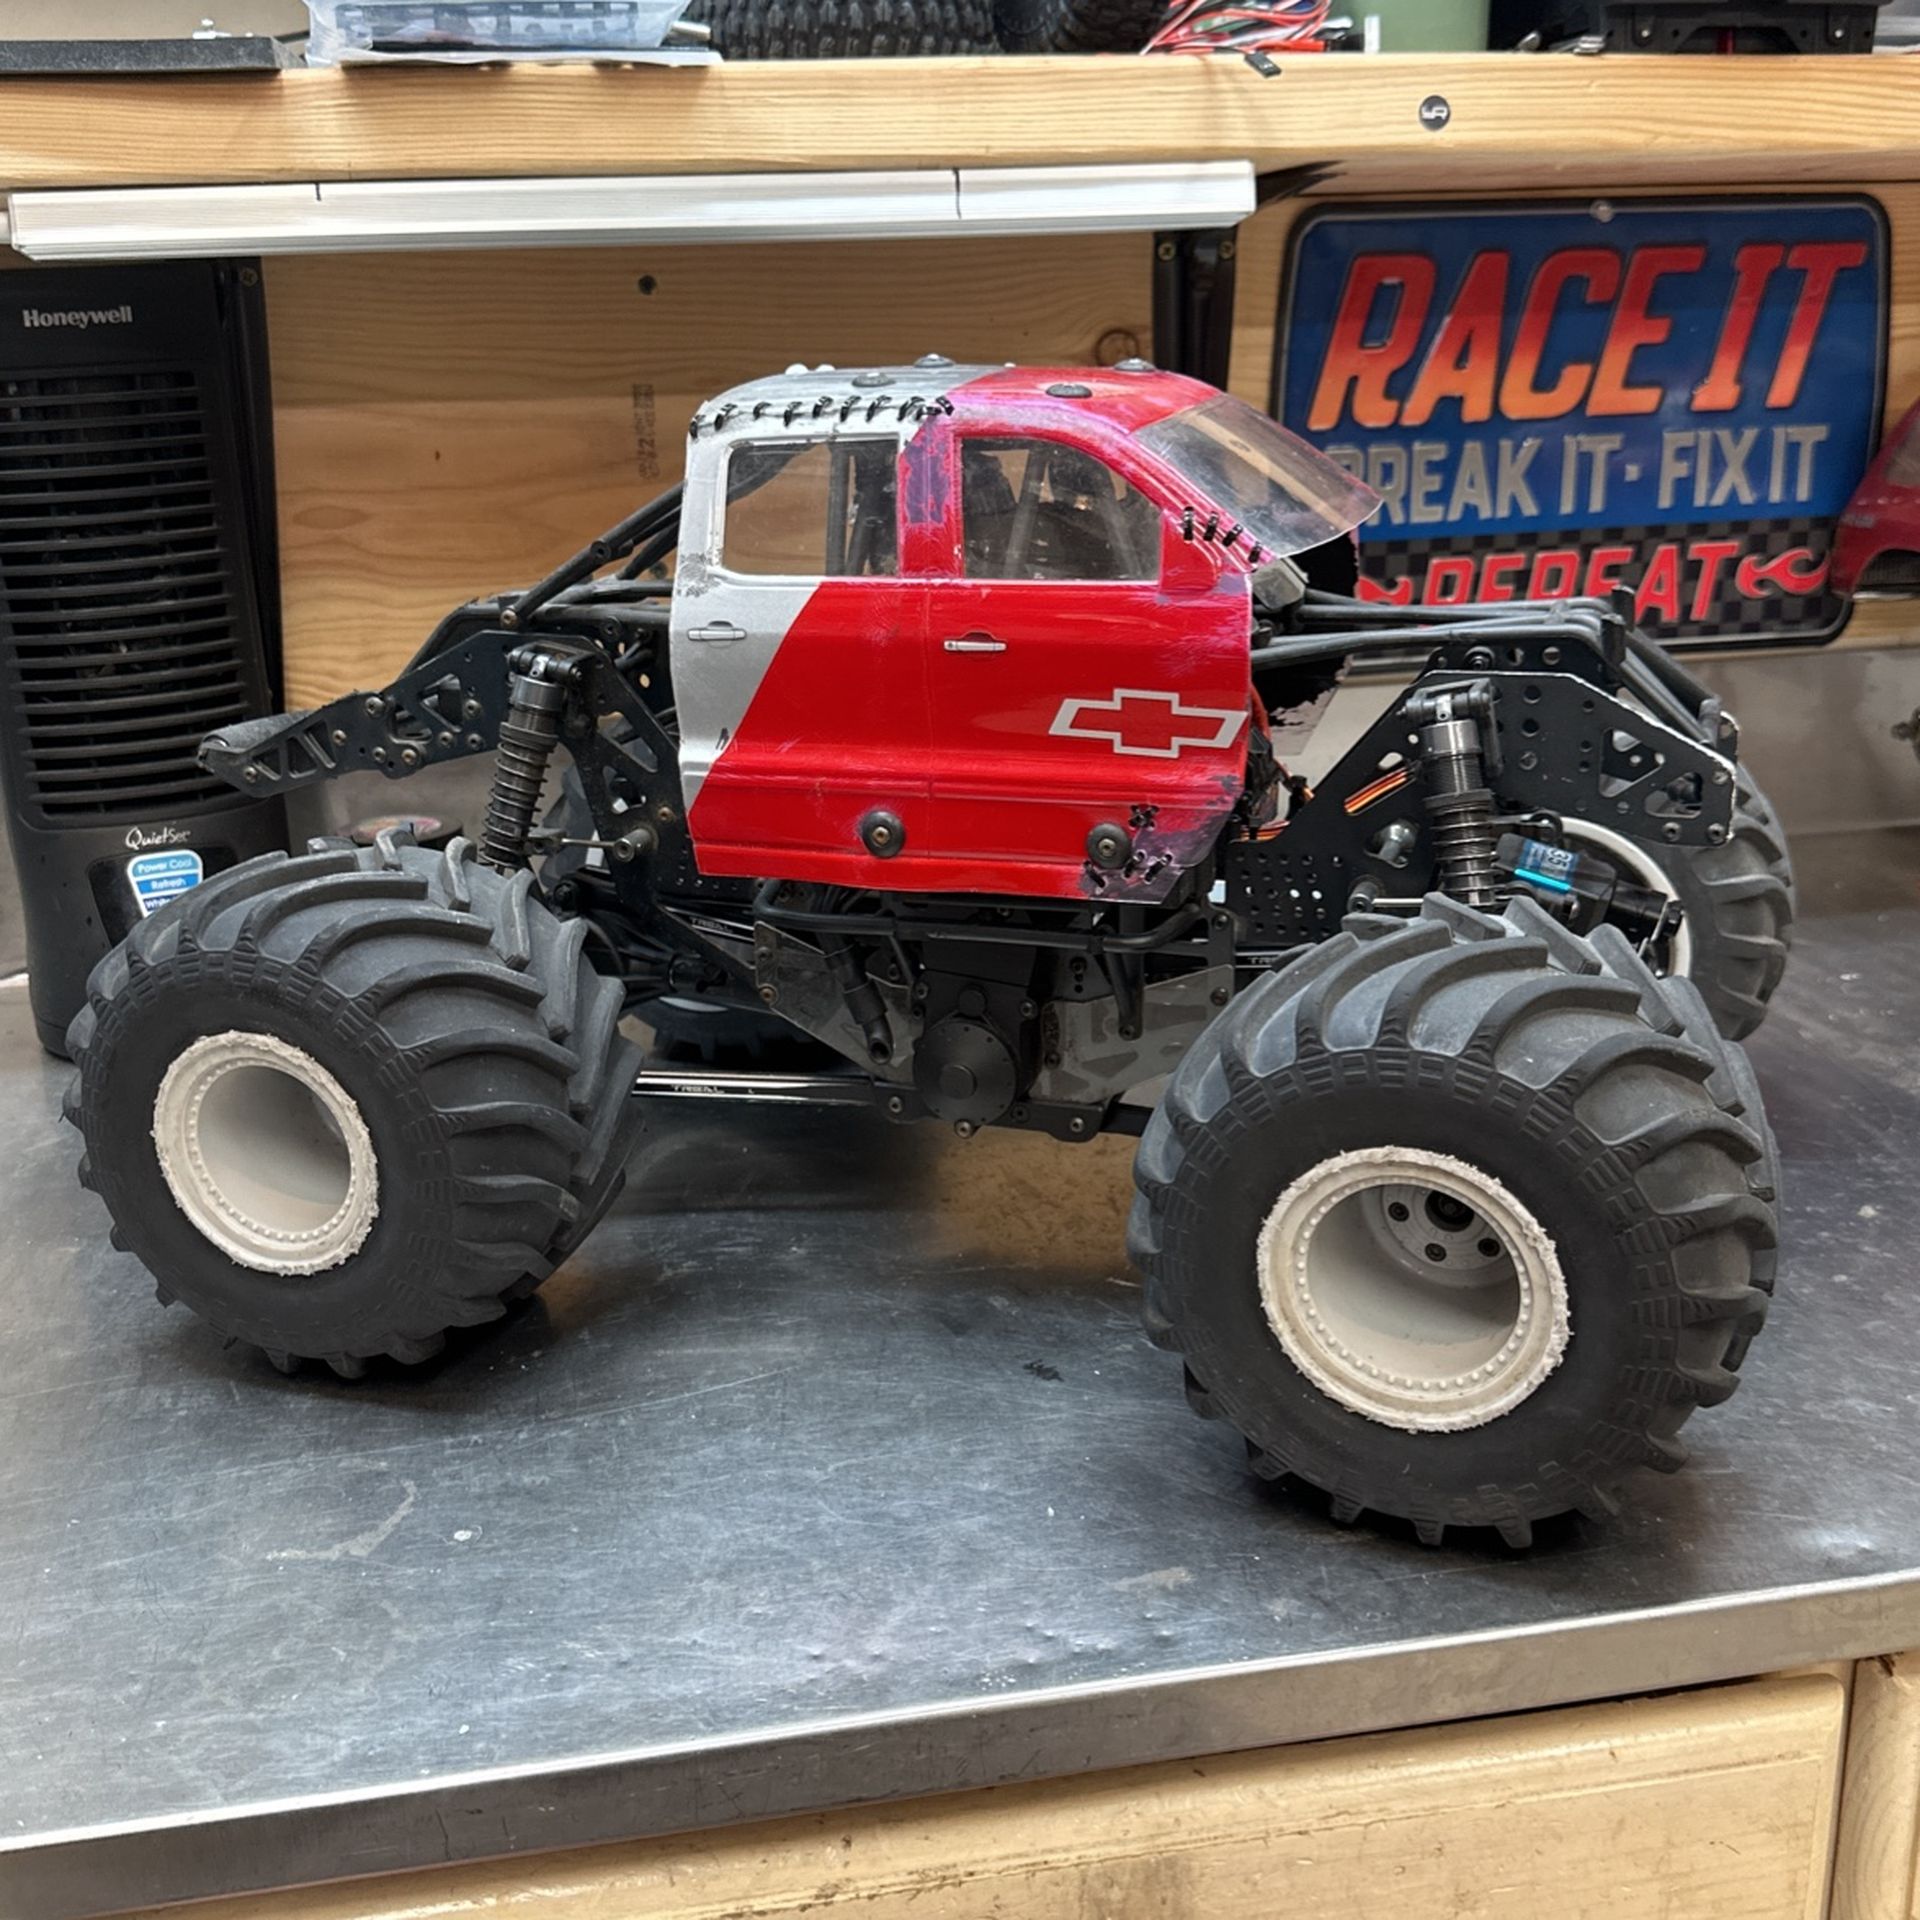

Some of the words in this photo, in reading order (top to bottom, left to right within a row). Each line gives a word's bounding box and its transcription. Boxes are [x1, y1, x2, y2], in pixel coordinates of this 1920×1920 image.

[22, 305, 134, 329] Honeywell
[1307, 245, 1704, 431] RACE
[1690, 241, 1868, 412] IT
[1559, 433, 1624, 515] IT
[1657, 426, 1756, 511] FIX
[1768, 424, 1829, 504] IT
[138, 861, 168, 874] Power
[169, 857, 193, 870] Cool
[151, 877, 187, 890] Refresh
